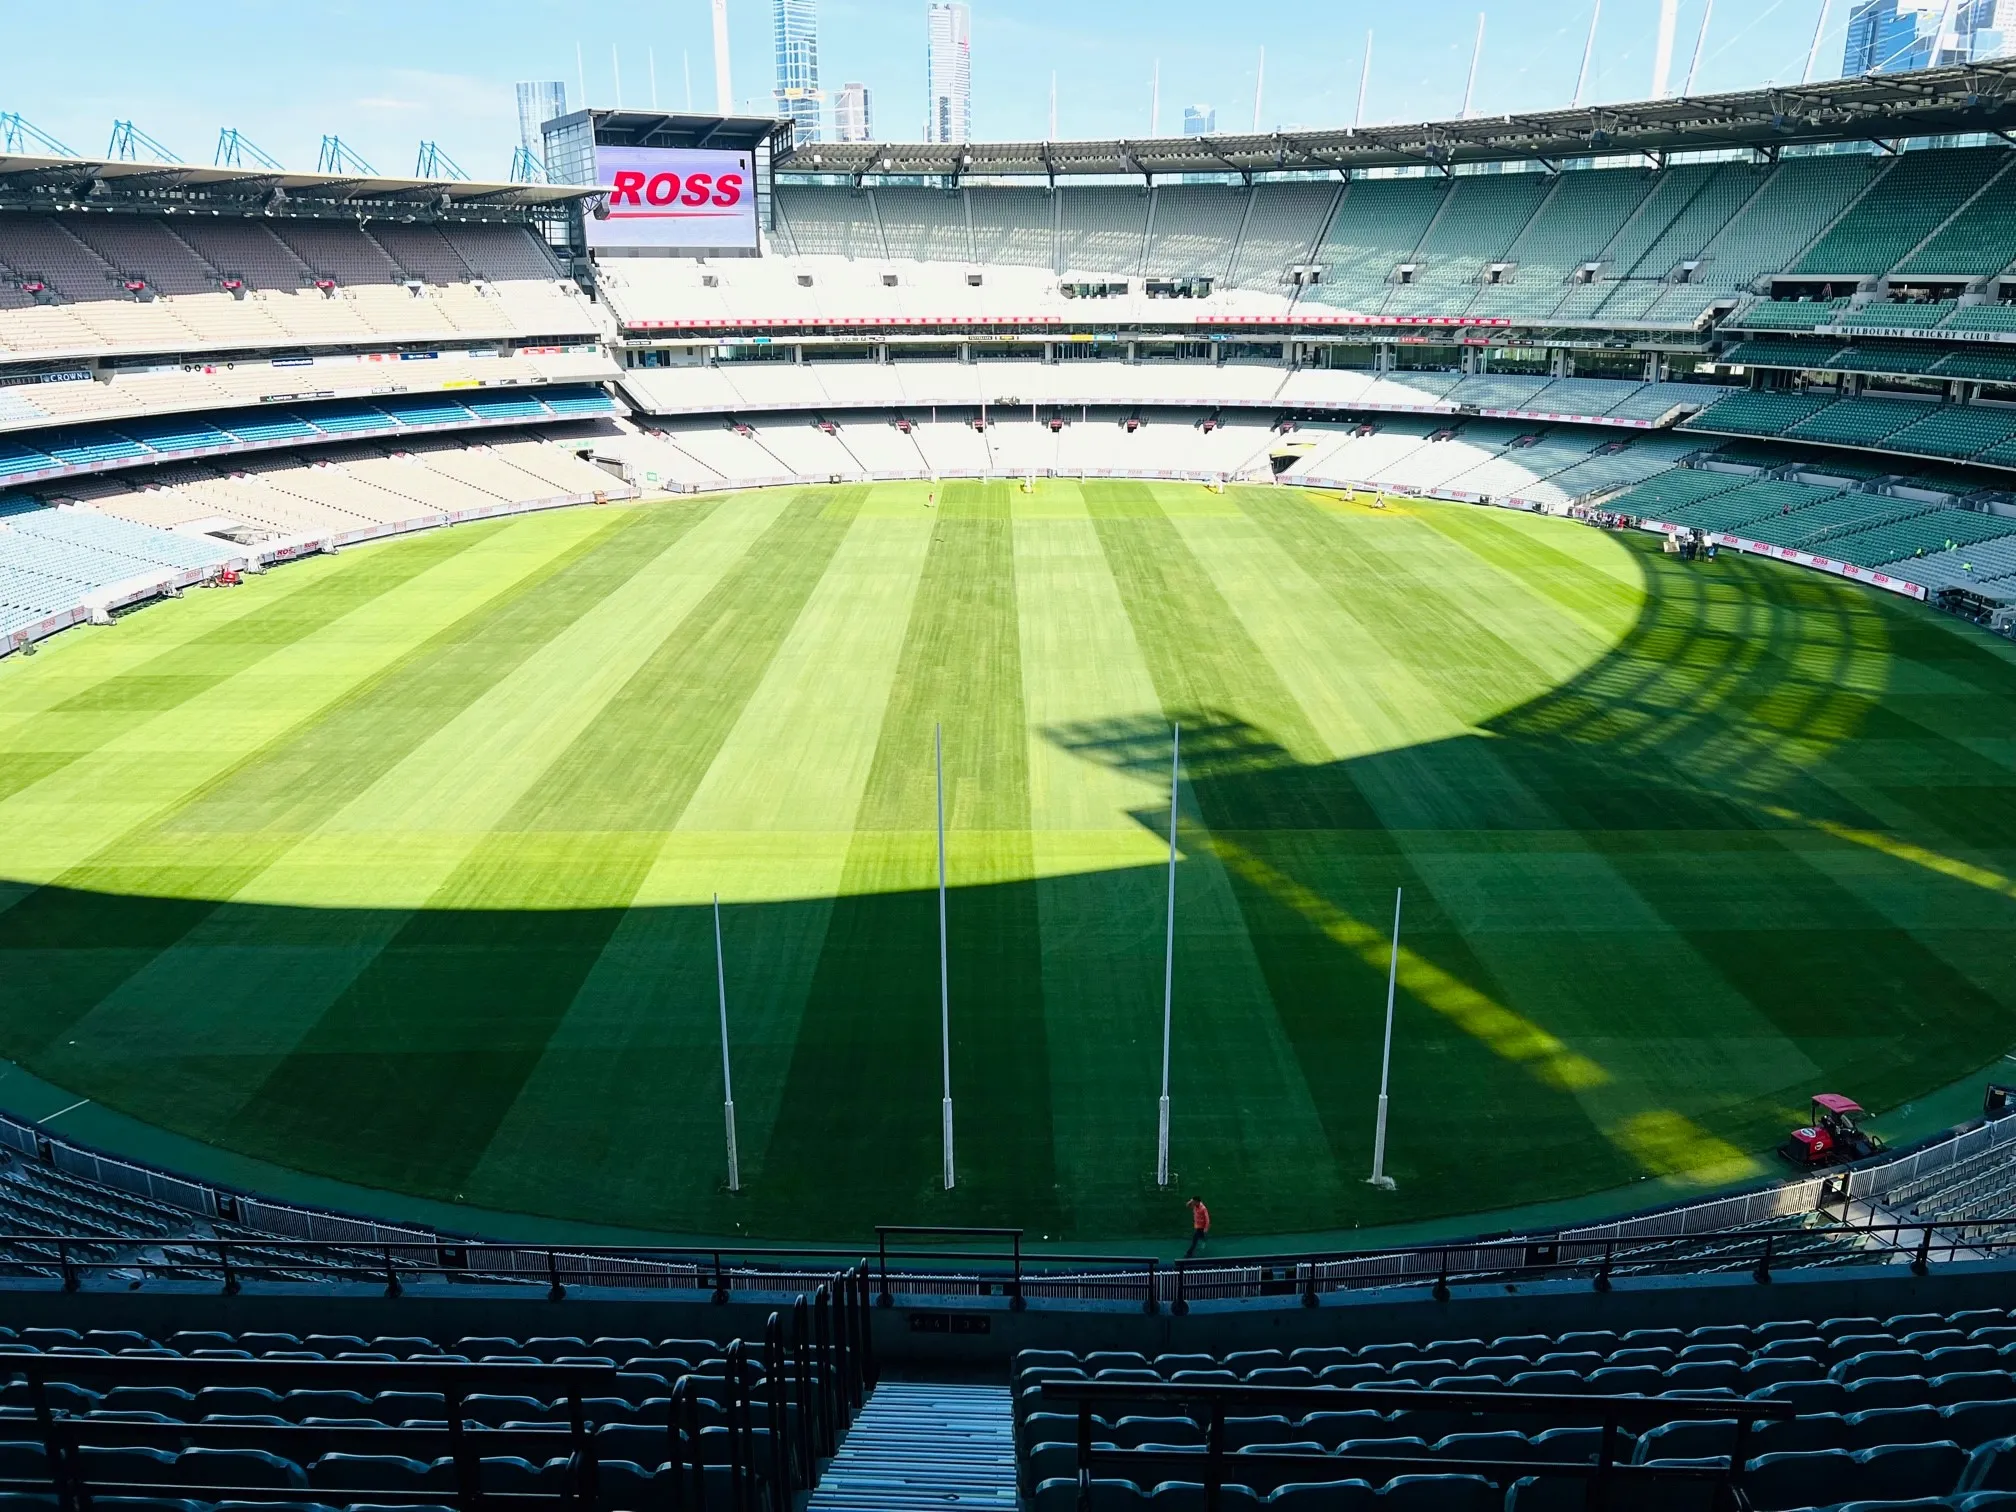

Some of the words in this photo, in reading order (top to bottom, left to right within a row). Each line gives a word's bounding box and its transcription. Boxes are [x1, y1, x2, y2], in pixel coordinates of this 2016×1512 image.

[609, 171, 743, 207] ROSS
[1841, 327, 1905, 336] MELBOURNE
[1912, 330, 1958, 338] CRICKET
[1963, 332, 1991, 341] CLUB
[50, 372, 83, 382] CROWN
[1722, 535, 1738, 544] ROSS
[1753, 543, 1770, 551] ROSS
[1782, 549, 1798, 557] ROSS
[1812, 557, 1829, 566] ROSS
[1843, 564, 1859, 573] ROSS
[1873, 574, 1889, 583] ROSS
[41, 618, 56, 630] ROSS
